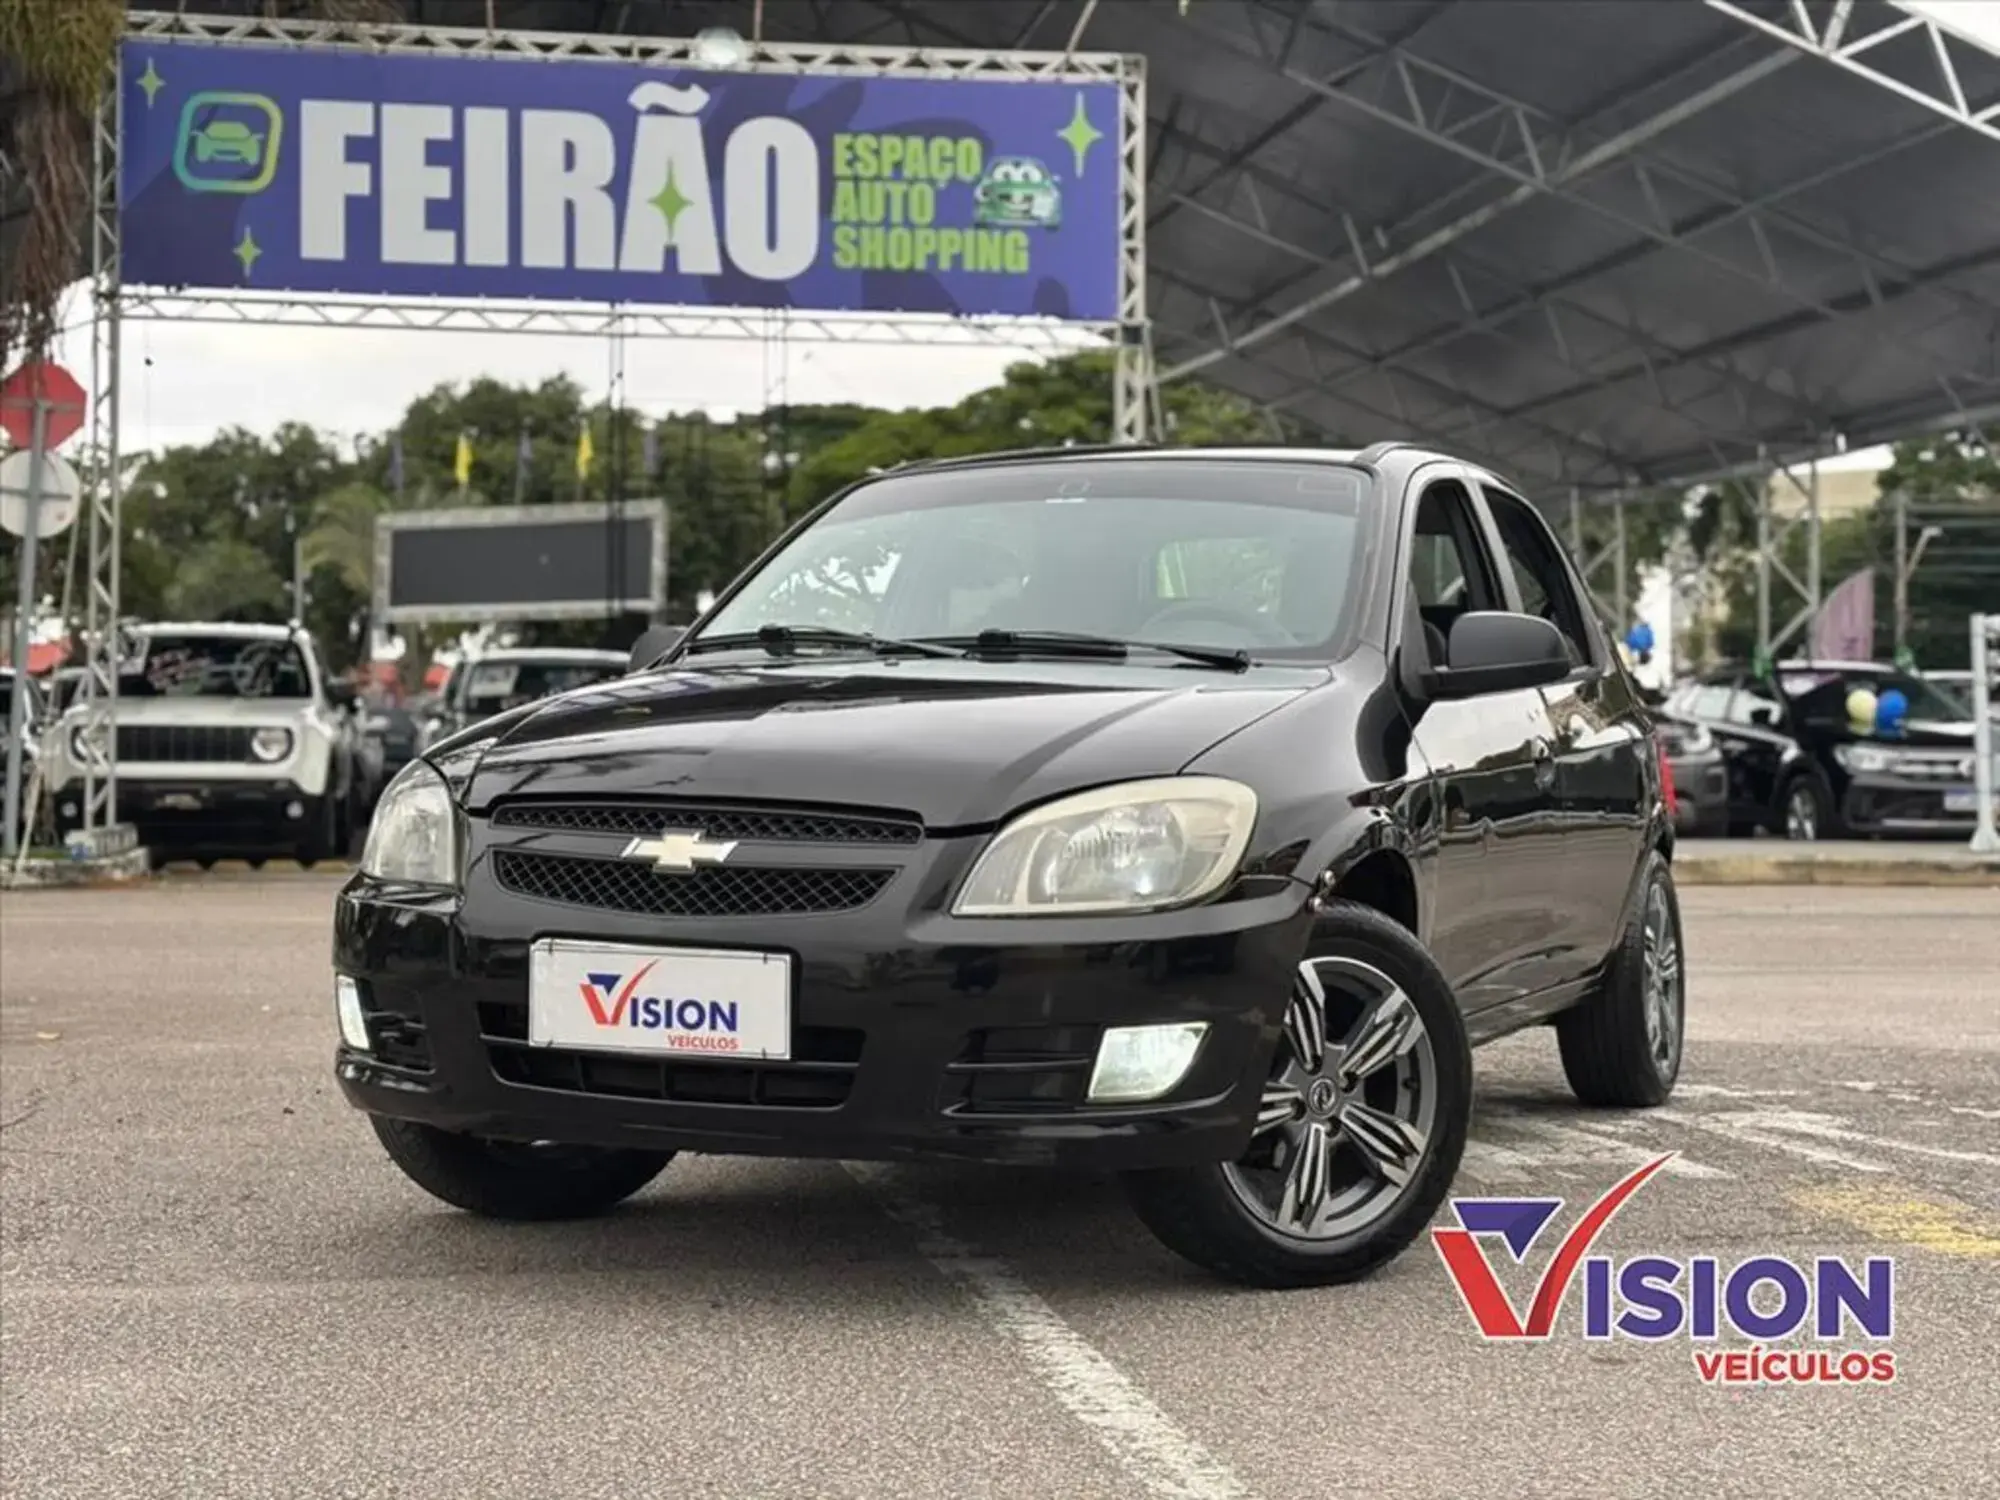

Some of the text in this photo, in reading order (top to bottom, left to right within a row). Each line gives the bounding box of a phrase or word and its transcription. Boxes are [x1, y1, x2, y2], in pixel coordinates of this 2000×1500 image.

[301, 82, 819, 280] FEIRÃO
[834, 134, 982, 187] ESPAÇO
[833, 180, 934, 225] AUTO
[834, 227, 1029, 273] SHOPPING
[579, 958, 738, 1032] VISION
